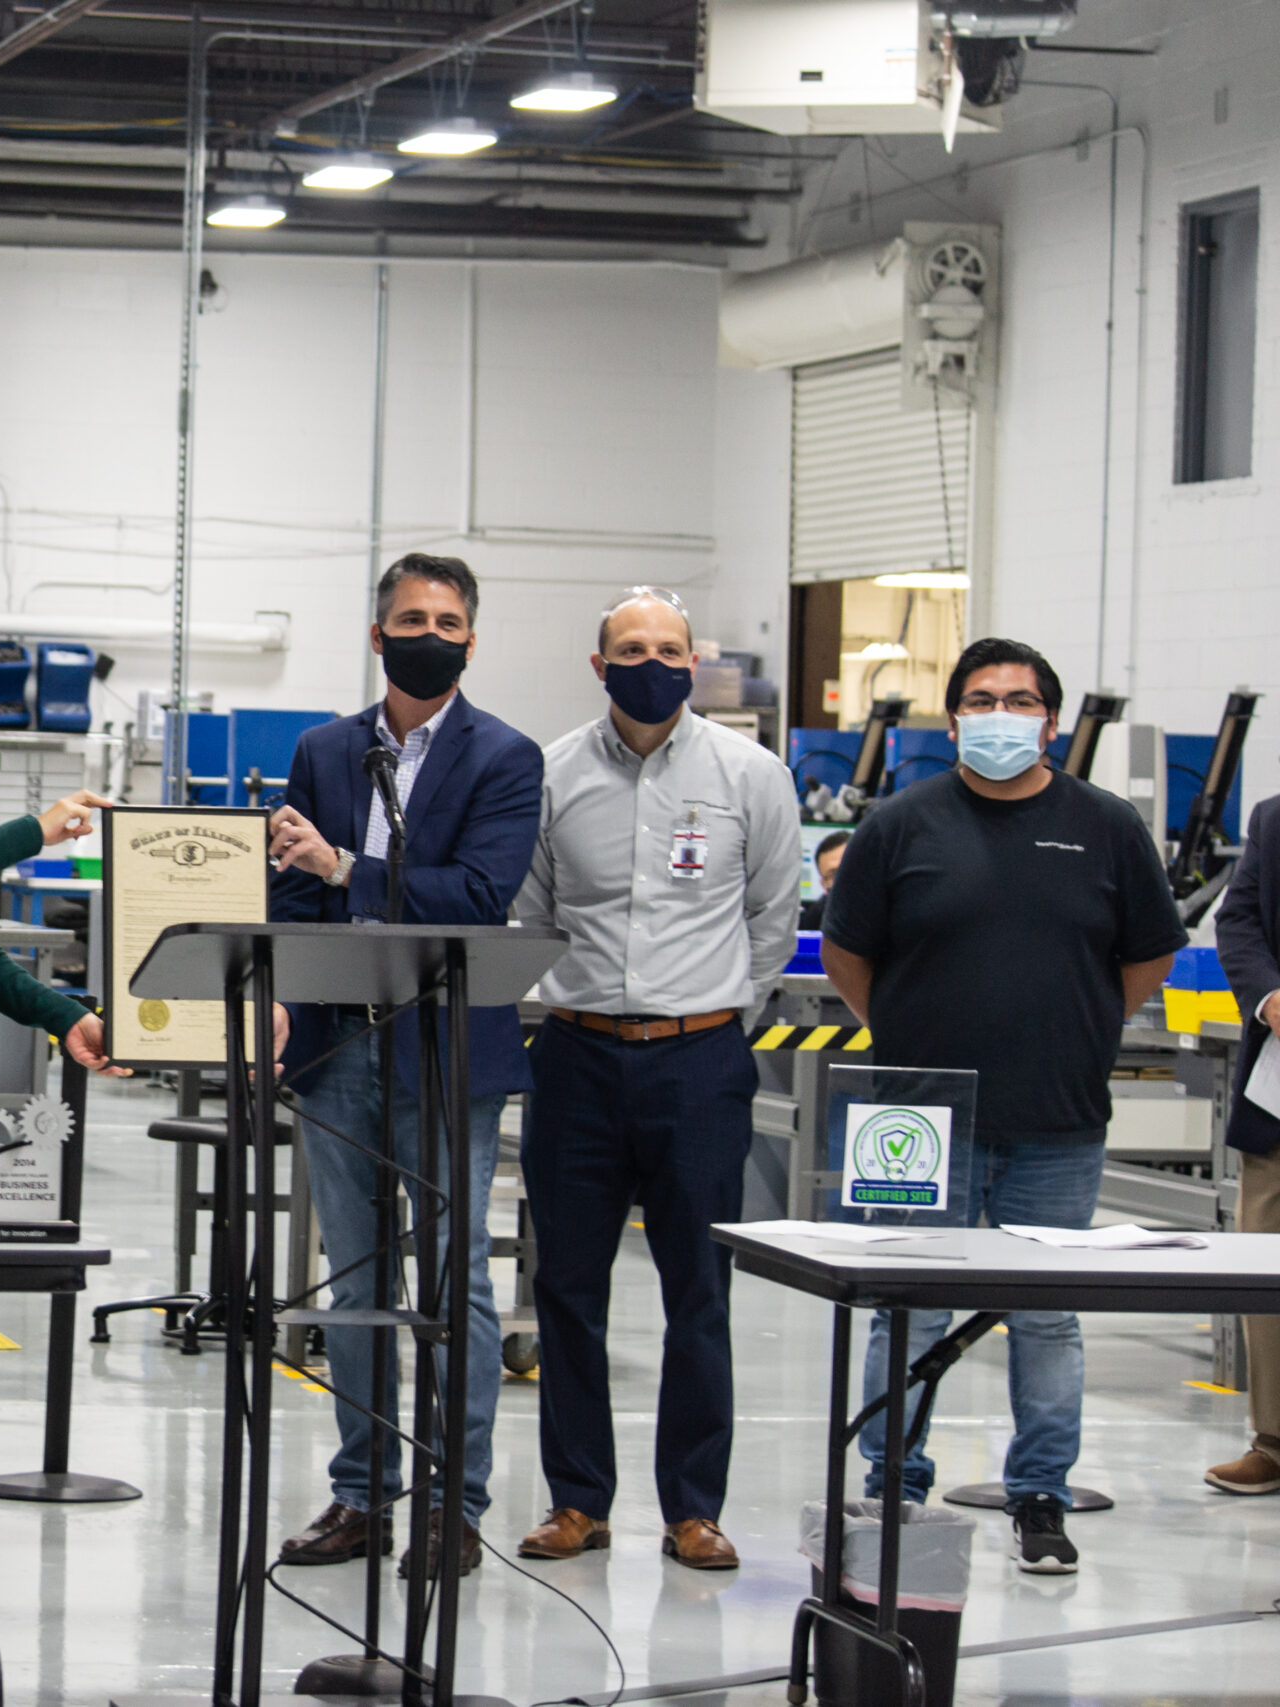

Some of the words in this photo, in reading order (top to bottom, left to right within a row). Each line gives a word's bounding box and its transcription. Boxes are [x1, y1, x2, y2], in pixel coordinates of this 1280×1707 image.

[13, 1158, 36, 1167] 2014
[0, 1181, 49, 1189] BUSINESS
[855, 1189, 908, 1202] CERTIFIED
[910, 1191, 932, 1203] SITE
